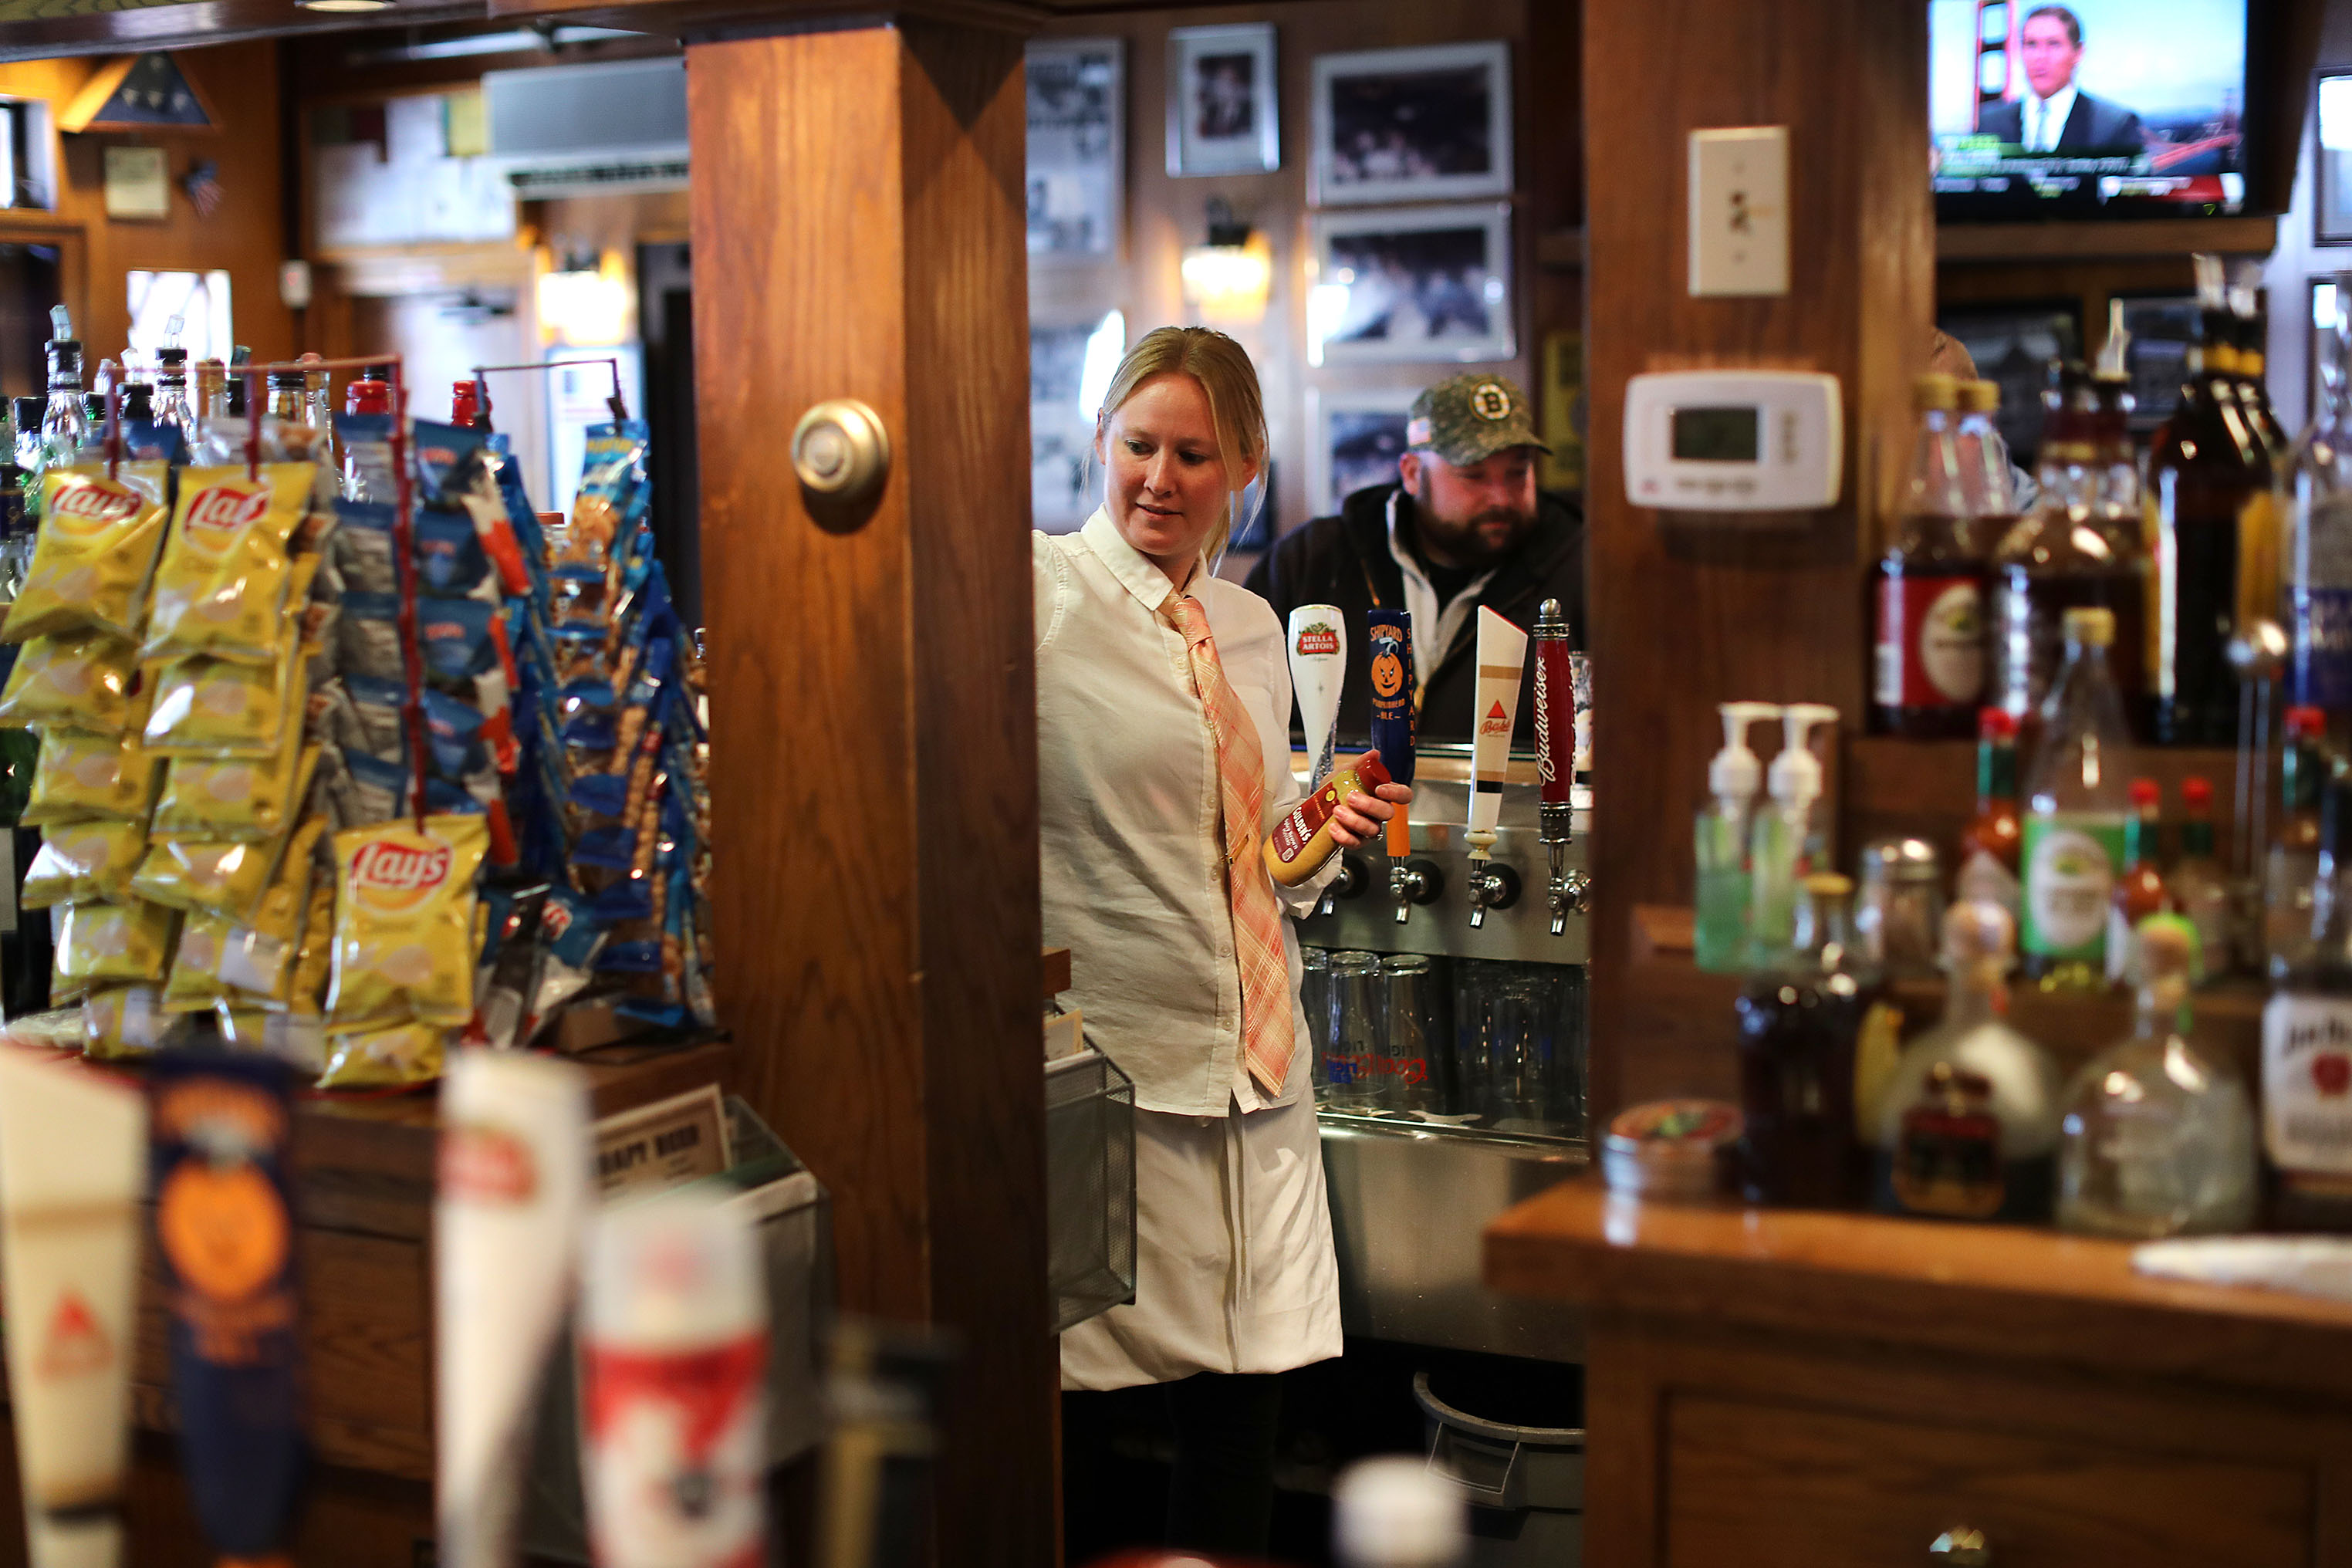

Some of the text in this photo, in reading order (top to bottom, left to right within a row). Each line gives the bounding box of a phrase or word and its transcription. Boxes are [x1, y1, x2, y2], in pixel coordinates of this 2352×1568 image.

[1370, 624, 1403, 642] SHIPYARD
[1407, 628, 1415, 746] SHIPYARD
[1534, 656, 1556, 786] Budweiser
